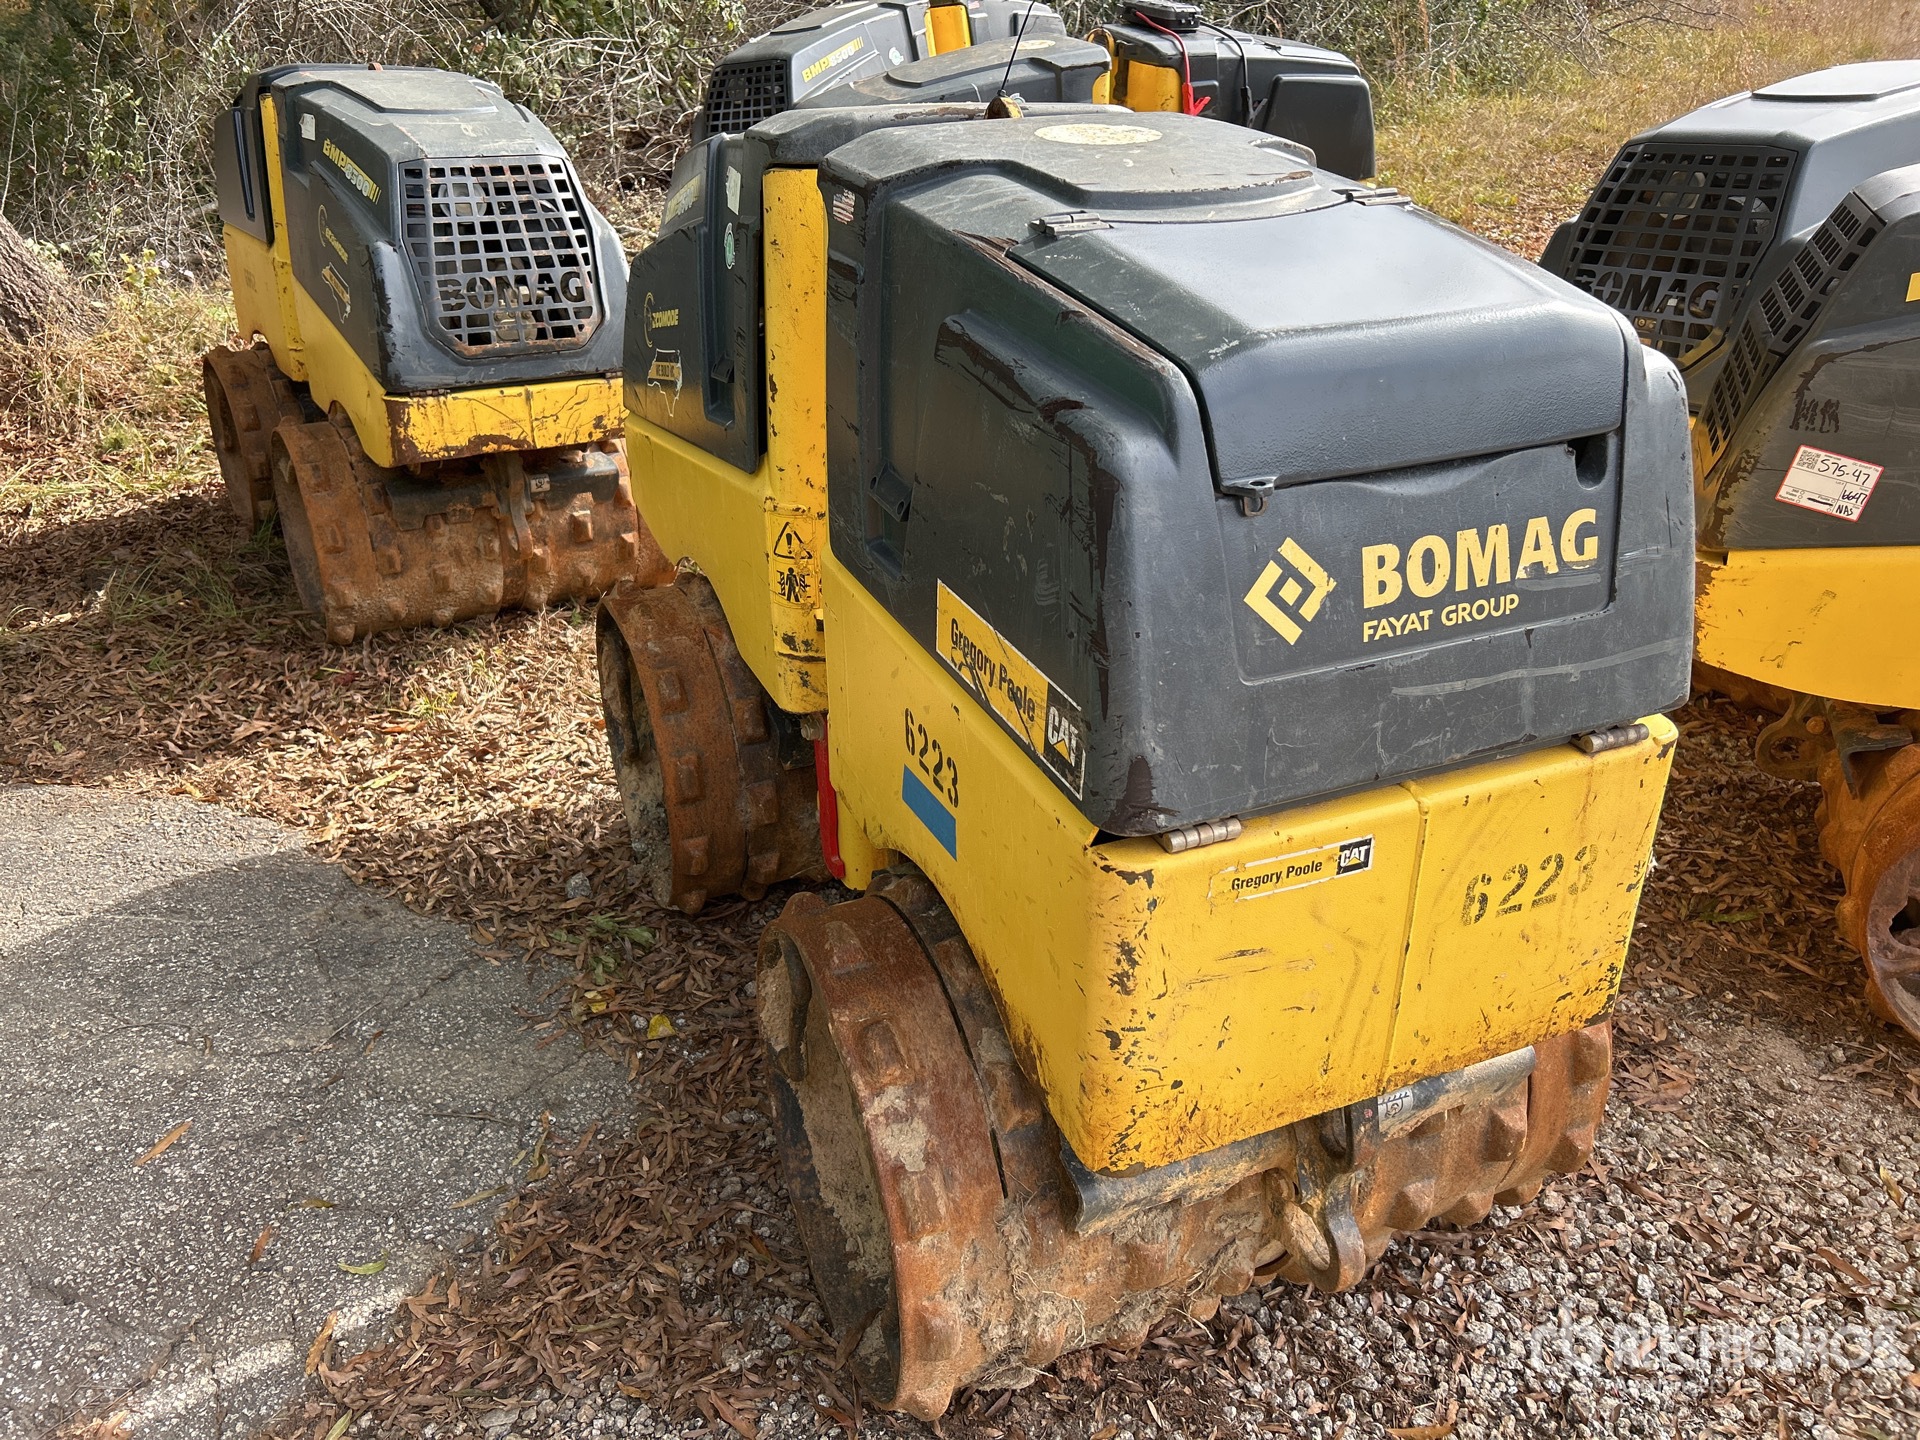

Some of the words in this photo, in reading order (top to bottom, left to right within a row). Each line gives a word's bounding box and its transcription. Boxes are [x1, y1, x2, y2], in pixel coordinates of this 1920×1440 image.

[437, 271, 586, 312] BOMAG
[1572, 268, 1721, 320] BOMAG
[1818, 458, 1871, 486] 575-47
[1362, 508, 1599, 609] BOMAG
[1363, 609, 1433, 642] FAYAT
[1441, 593, 1519, 627] GROUP
[951, 618, 996, 688] Gregory
[998, 664, 1036, 722] Poole
[1048, 706, 1079, 767] CAT
[904, 708, 959, 808] 6223
[1231, 868, 1283, 892] Gregory
[1286, 859, 1323, 879] Poole
[1339, 845, 1370, 868] CAT
[1462, 843, 1598, 926] 6223
